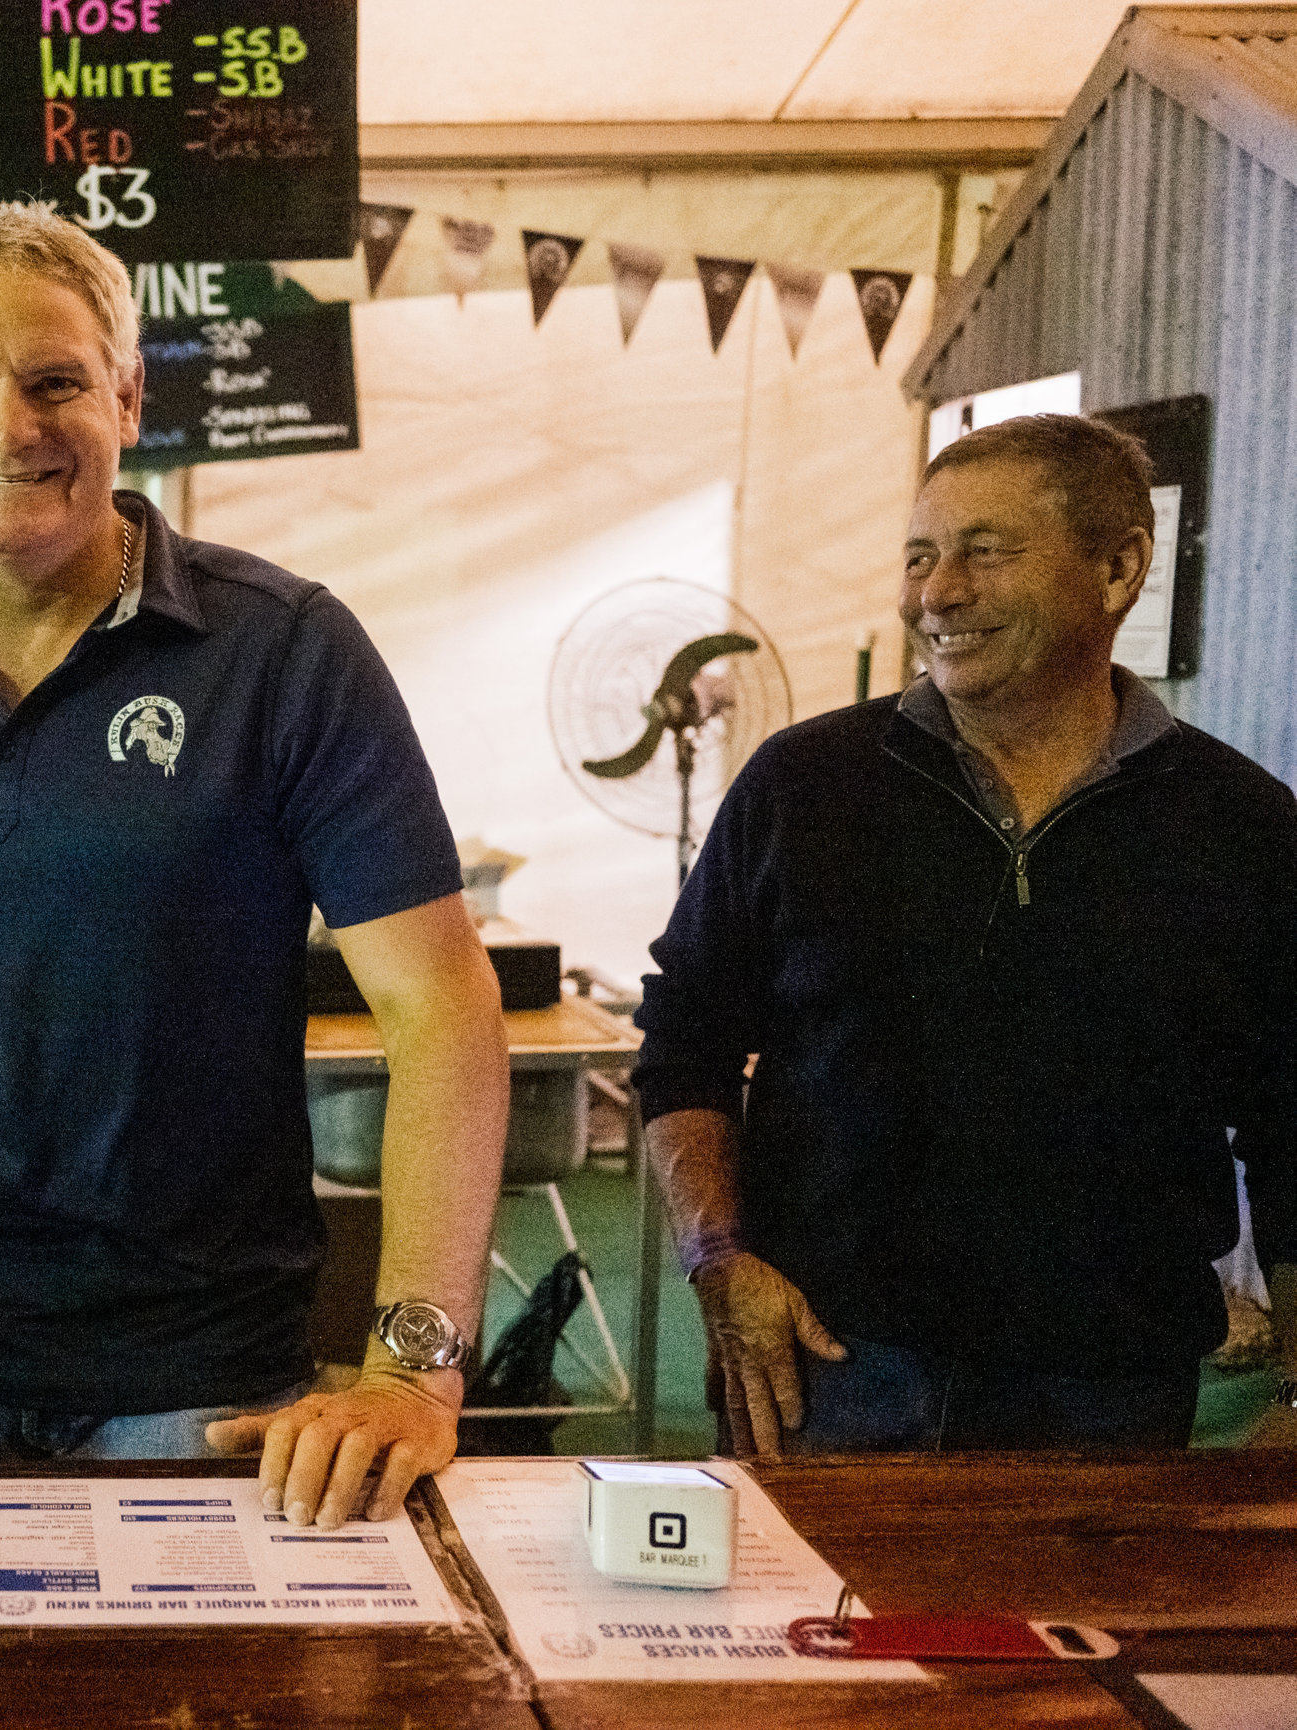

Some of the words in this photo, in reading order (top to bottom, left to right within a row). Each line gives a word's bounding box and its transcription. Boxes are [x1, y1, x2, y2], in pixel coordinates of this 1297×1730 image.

[39, 37, 173, 98] WHITE
[43, 101, 133, 164] RED
[76, 165, 157, 231] $3
[133, 262, 229, 319] INE
[110, 708, 130, 745] KULIN
[133, 697, 170, 709] BUSH
[169, 706, 183, 748] RACES
[639, 1551, 657, 1563] BAR
[660, 1553, 700, 1568] MARQUEE
[45, 1600, 90, 1609] MENU
[95, 1600, 152, 1609] DRINKS
[158, 1600, 188, 1609] BAR
[195, 1599, 267, 1609] MARQUEE
[271, 1599, 321, 1609] RACES
[325, 1599, 367, 1608] BUSH
[372, 1598, 419, 1608] KULIN
[598, 1624, 679, 1639] PRICES
[686, 1625, 733, 1639] BAR
[641, 1644, 716, 1658] RACES
[723, 1644, 786, 1658] BUSH
